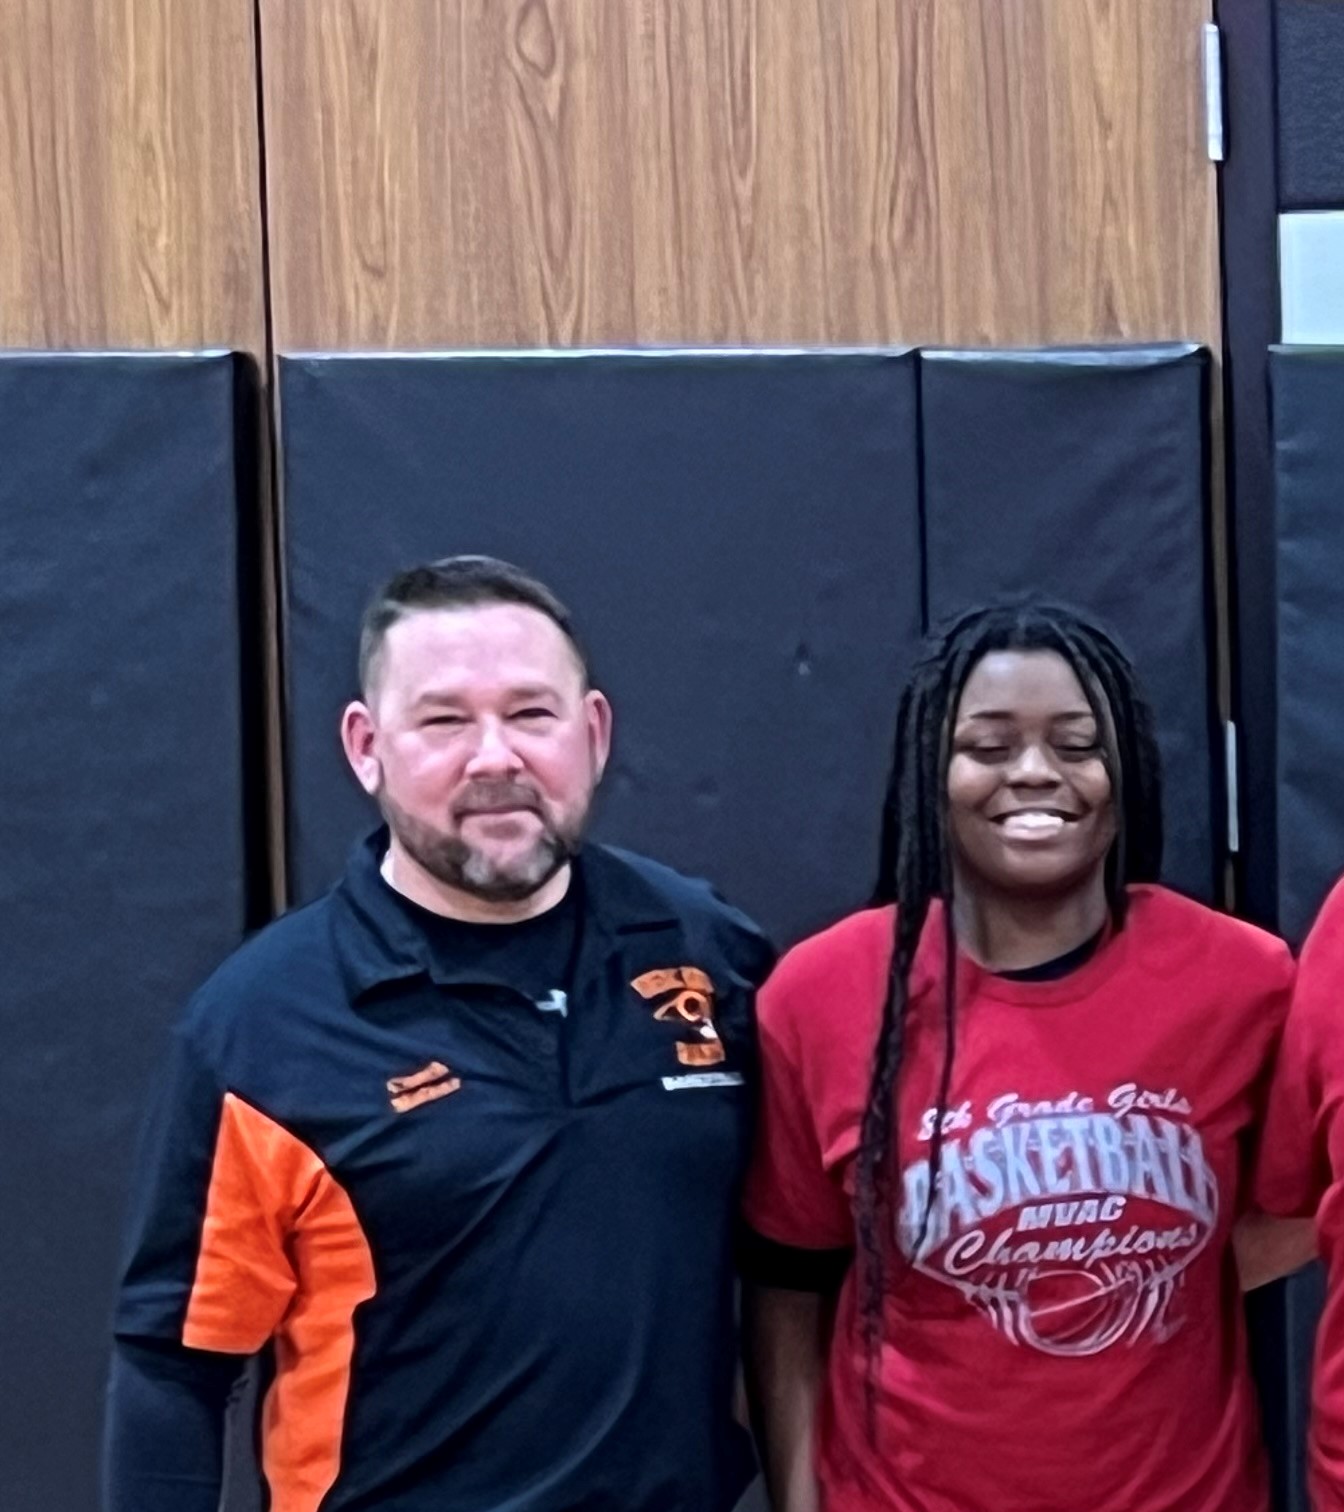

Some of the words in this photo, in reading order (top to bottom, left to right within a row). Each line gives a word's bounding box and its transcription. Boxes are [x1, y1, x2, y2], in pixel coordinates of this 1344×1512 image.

[987, 1091, 1094, 1129] Grade
[1017, 1195, 1127, 1232] MVAC
[944, 1223, 1197, 1275] Champions
